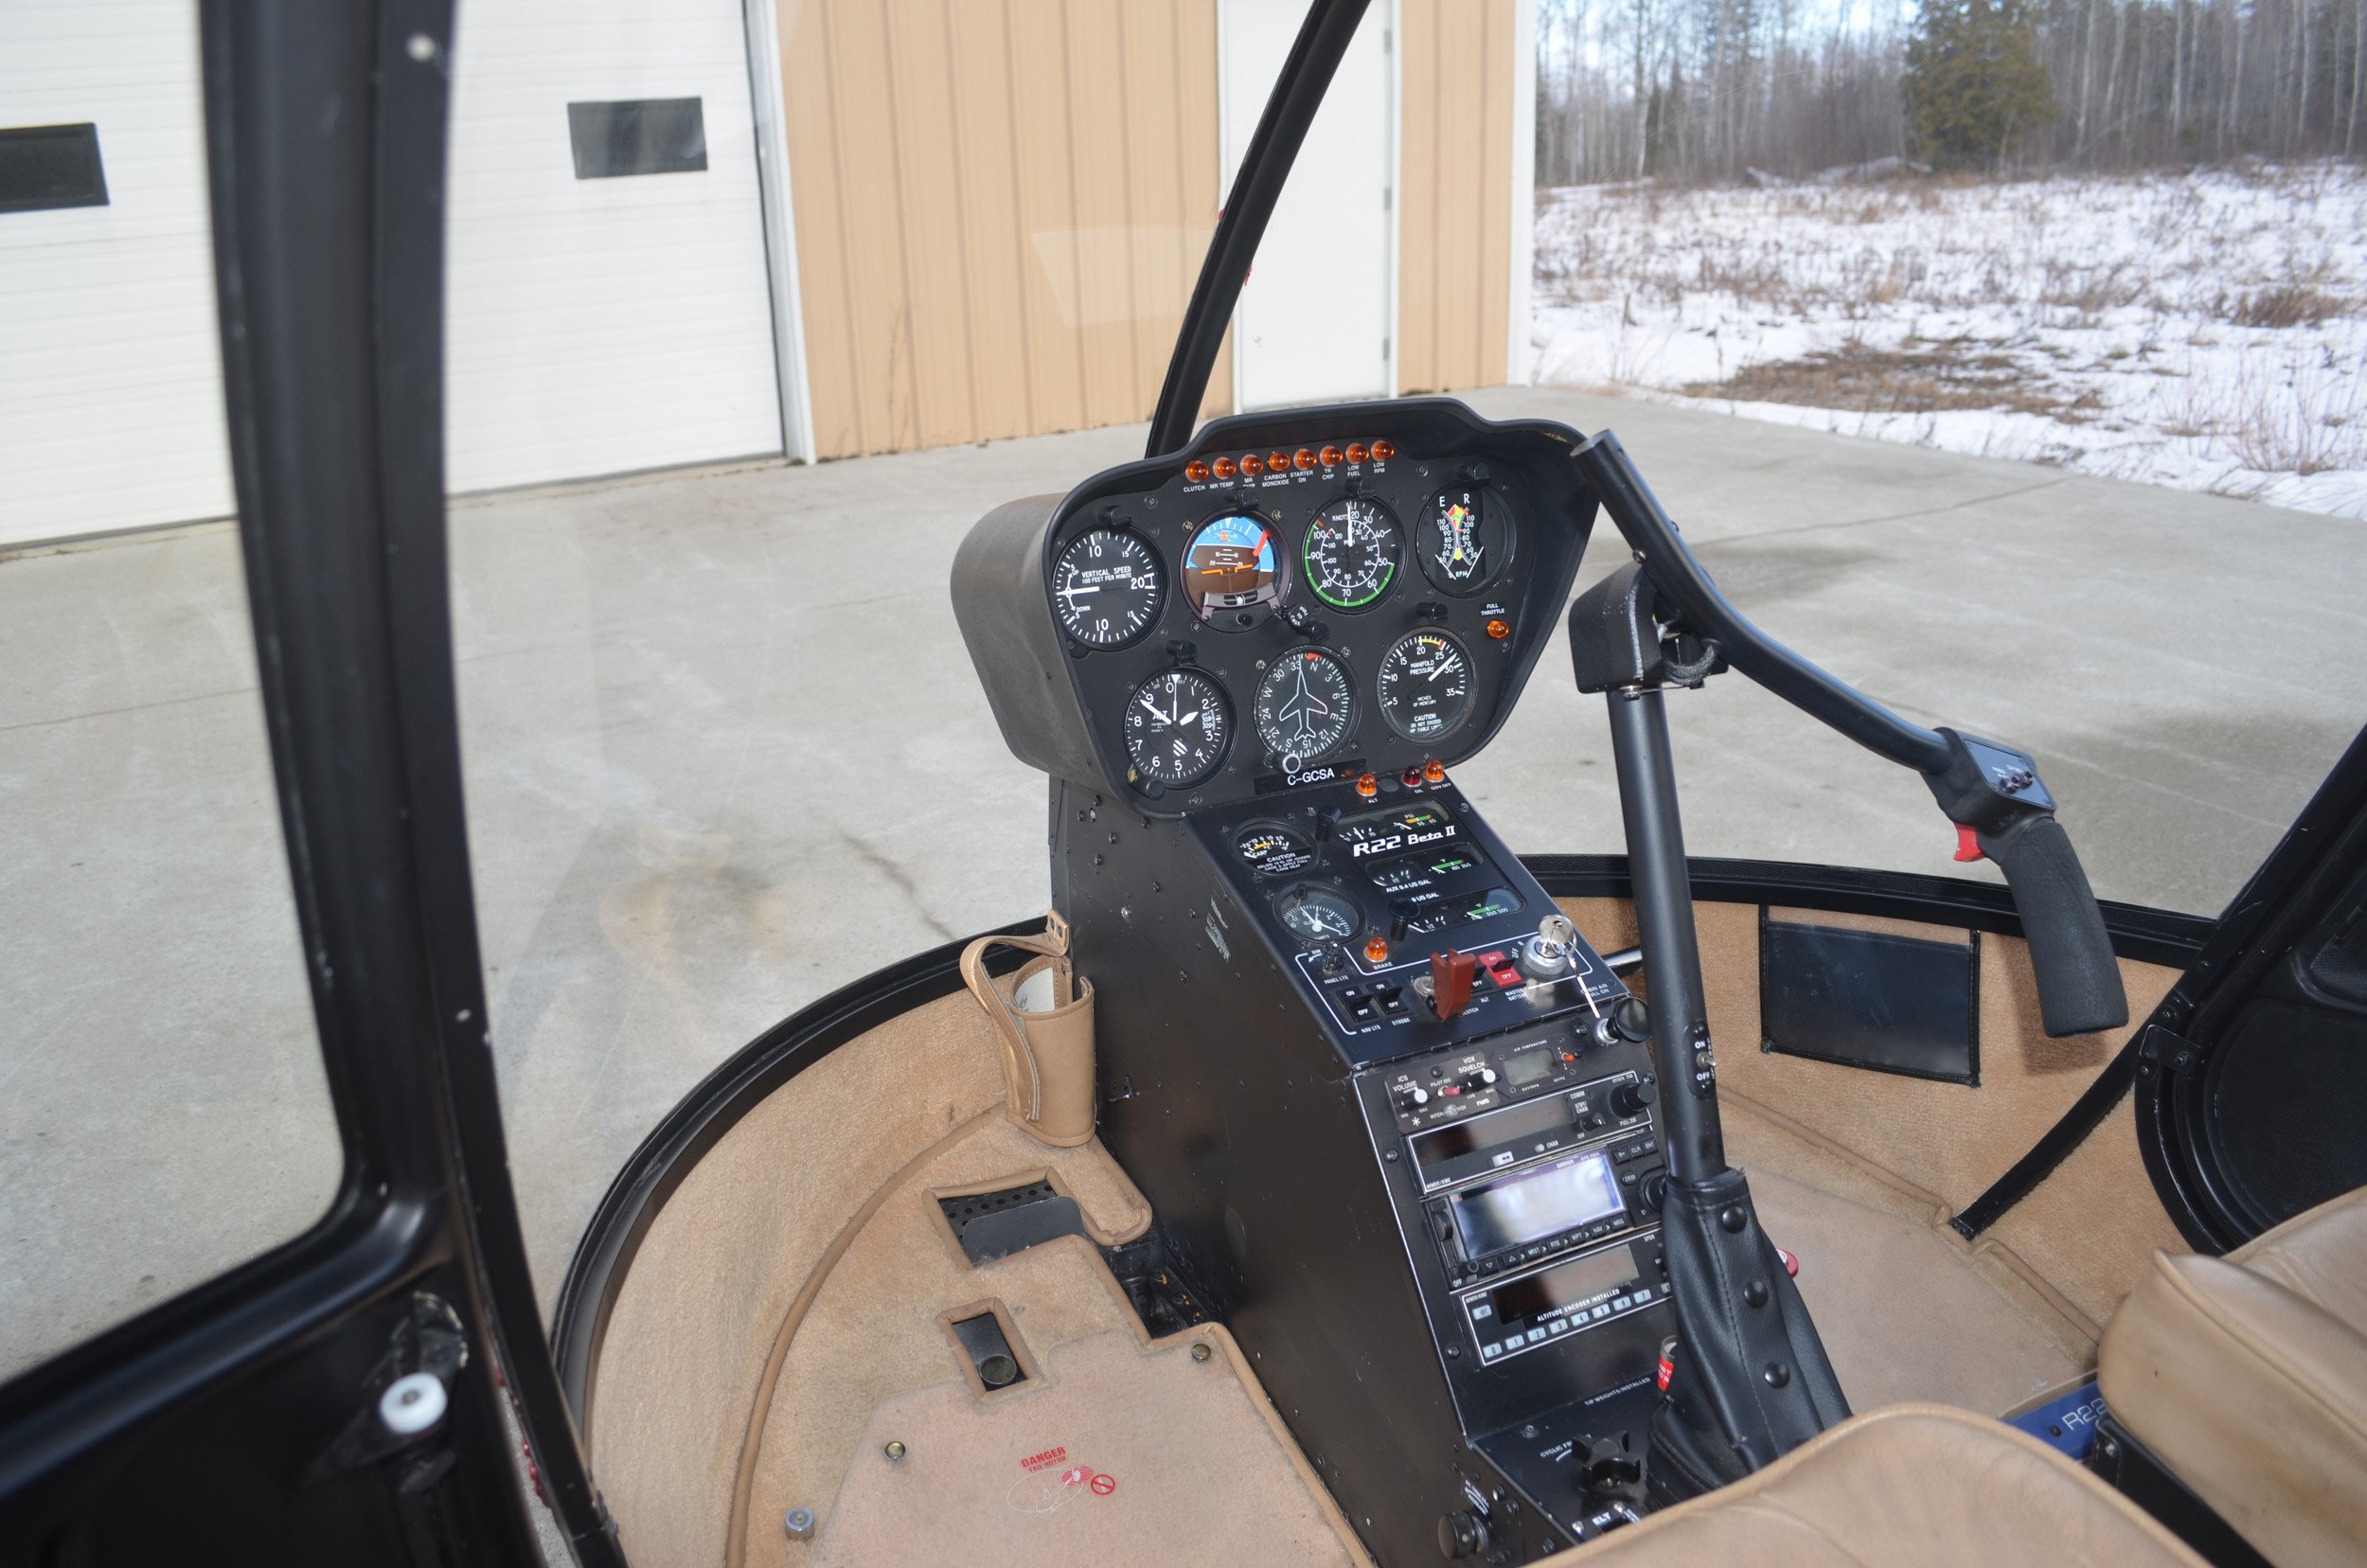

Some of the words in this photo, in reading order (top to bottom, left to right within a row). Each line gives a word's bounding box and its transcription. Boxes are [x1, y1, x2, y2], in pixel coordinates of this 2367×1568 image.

[1262, 479, 1290, 488] MONOXIDE
[1439, 496, 1445, 507] E
[1464, 493, 1469, 504] R
[1313, 530, 1326, 539] 100
[1090, 545, 1101, 558] 10
[1081, 568, 1110, 579] VERTICAL
[1113, 565, 1131, 574] SPEED
[1130, 577, 1145, 589] 20
[1367, 579, 1377, 588] 60
[1096, 618, 1109, 632] 10
[1290, 662, 1301, 671] 33
[1310, 662, 1318, 671] N
[1411, 660, 1434, 668] MANIFOLD
[1273, 669, 1284, 682] 30
[1326, 673, 1332, 682] 3
[1166, 683, 1173, 693] 0
[1263, 687, 1273, 699] W
[1146, 694, 1153, 704] 9
[1201, 699, 1209, 709] 2
[1263, 707, 1271, 720] 24
[1330, 712, 1339, 721] E
[1415, 713, 1436, 722] CAUTION
[1134, 716, 1142, 726] 8
[1206, 731, 1213, 740] 3
[1269, 726, 1280, 739] 21
[1318, 728, 1328, 740] 12
[1135, 739, 1143, 750] 7
[1286, 739, 1292, 748] S
[1303, 739, 1311, 749] 15
[1195, 748, 1202, 757] 4
[1152, 757, 1160, 767] 6
[1175, 760, 1182, 770] 5
[1288, 768, 1334, 785] C-GCSA
[1353, 835, 1401, 857] R22
[1407, 831, 1443, 845] Beta
[1445, 826, 1456, 836] II
[1267, 852, 1296, 862] CAUTION
[1695, 1041, 1705, 1049] ON
[1458, 1061, 1486, 1073] SQUELCH
[1697, 1072, 1710, 1080] OFF
[1393, 1080, 1417, 1092] VOLUME
[1570, 1091, 1585, 1099] COMM
[1537, 1309, 1563, 1322] ALTITUDE
[1564, 1300, 1591, 1312] ENCODER
[1591, 1289, 1620, 1304] INSTALLED
[1594, 1389, 1620, 1402] WEIGHTS
[1621, 1377, 1650, 1393] INSTALLED
[2062, 1398, 2107, 1431] R22
[1540, 1446, 1563, 1458] CYCLIC
[1021, 1447, 1066, 1468] DANGER
[1044, 1456, 1067, 1468] ROTOR
[1593, 1512, 1611, 1524] ELT
